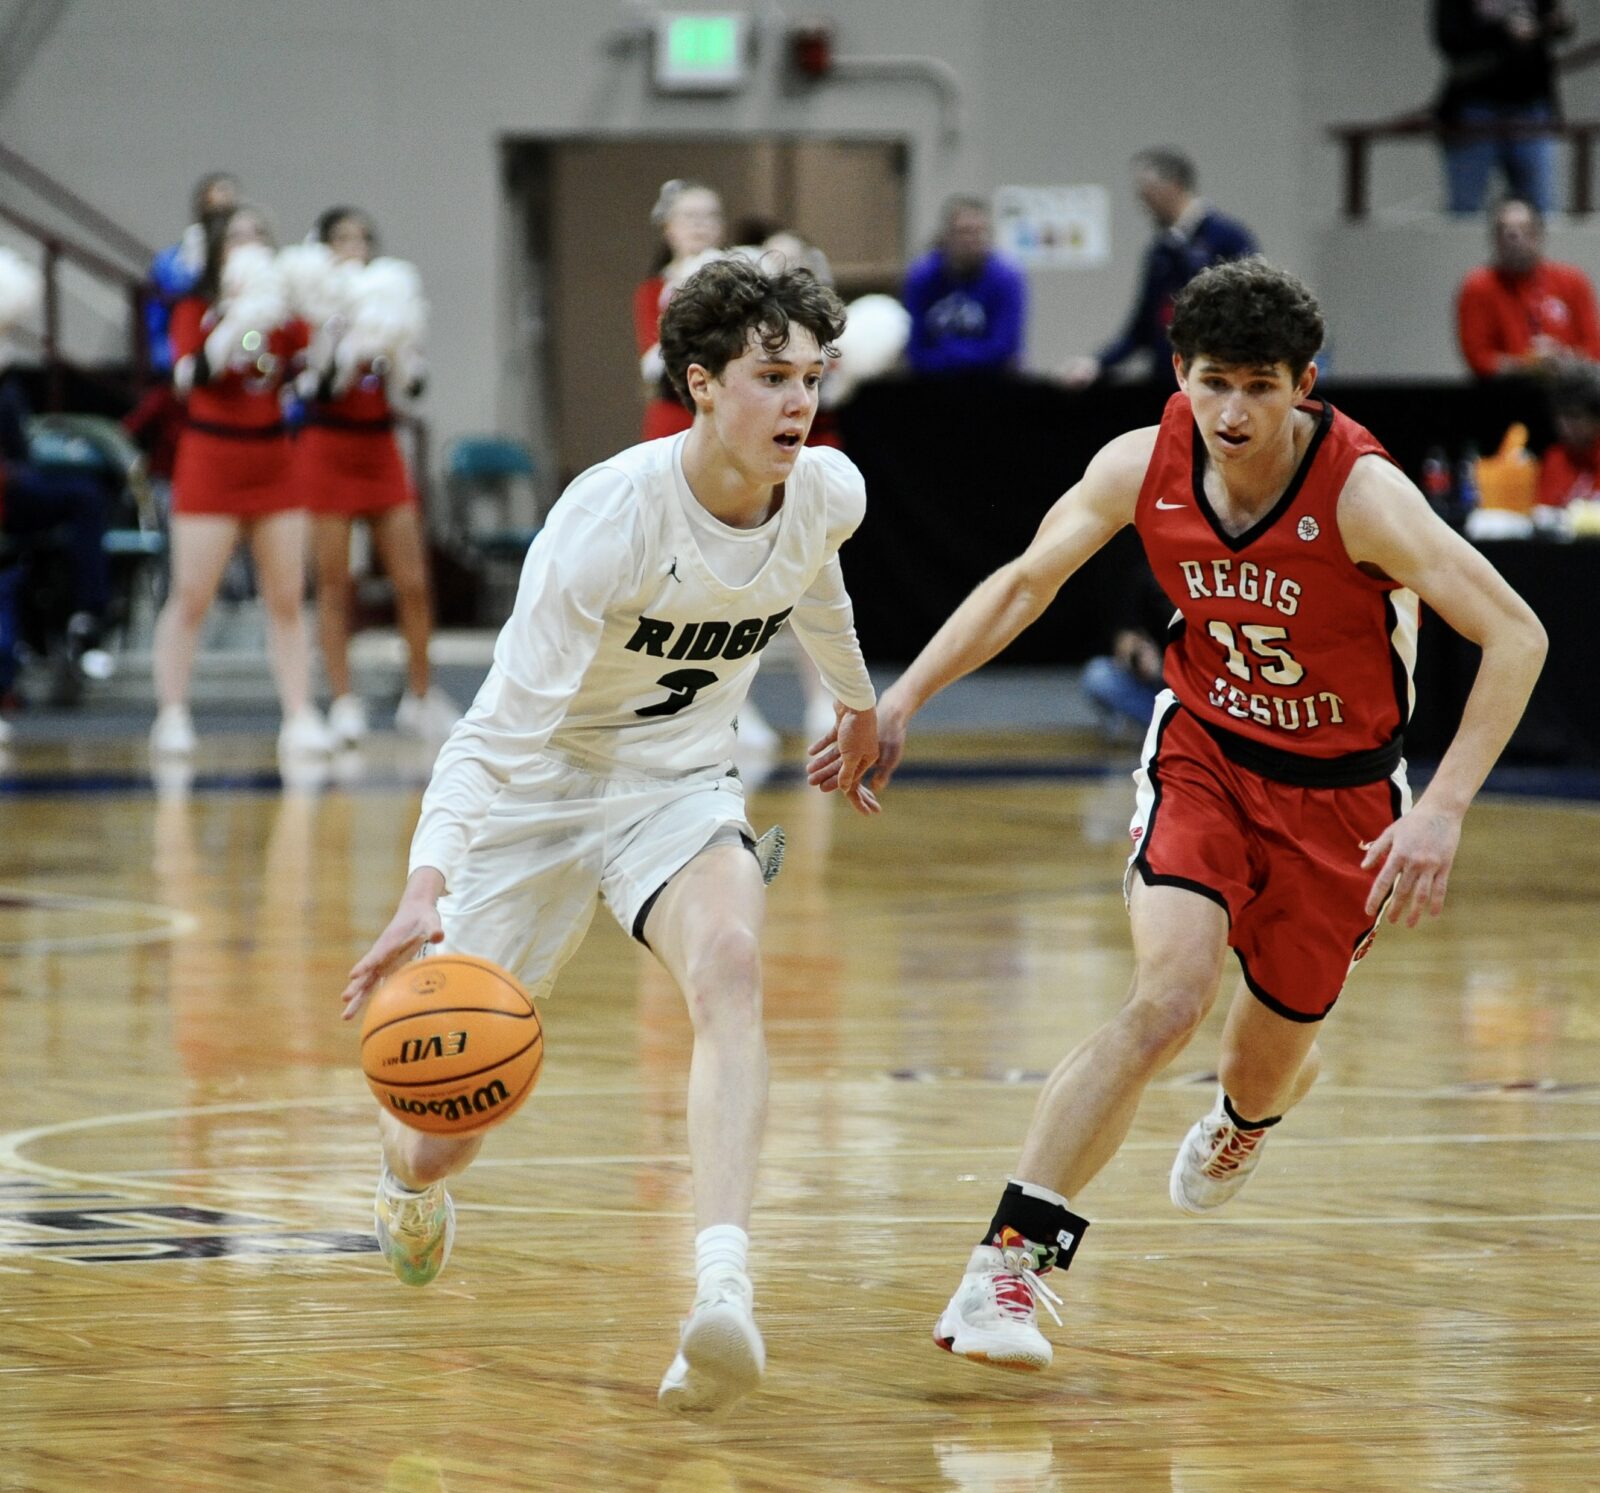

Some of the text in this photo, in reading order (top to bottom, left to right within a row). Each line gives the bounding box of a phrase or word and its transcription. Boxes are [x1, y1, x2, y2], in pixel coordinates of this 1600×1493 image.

[1178, 558, 1302, 616] REGIS
[1206, 620, 1305, 686] 15
[1208, 677, 1345, 730] JESUIT
[399, 1031, 468, 1065] EVO
[386, 1078, 511, 1121] Wilson
